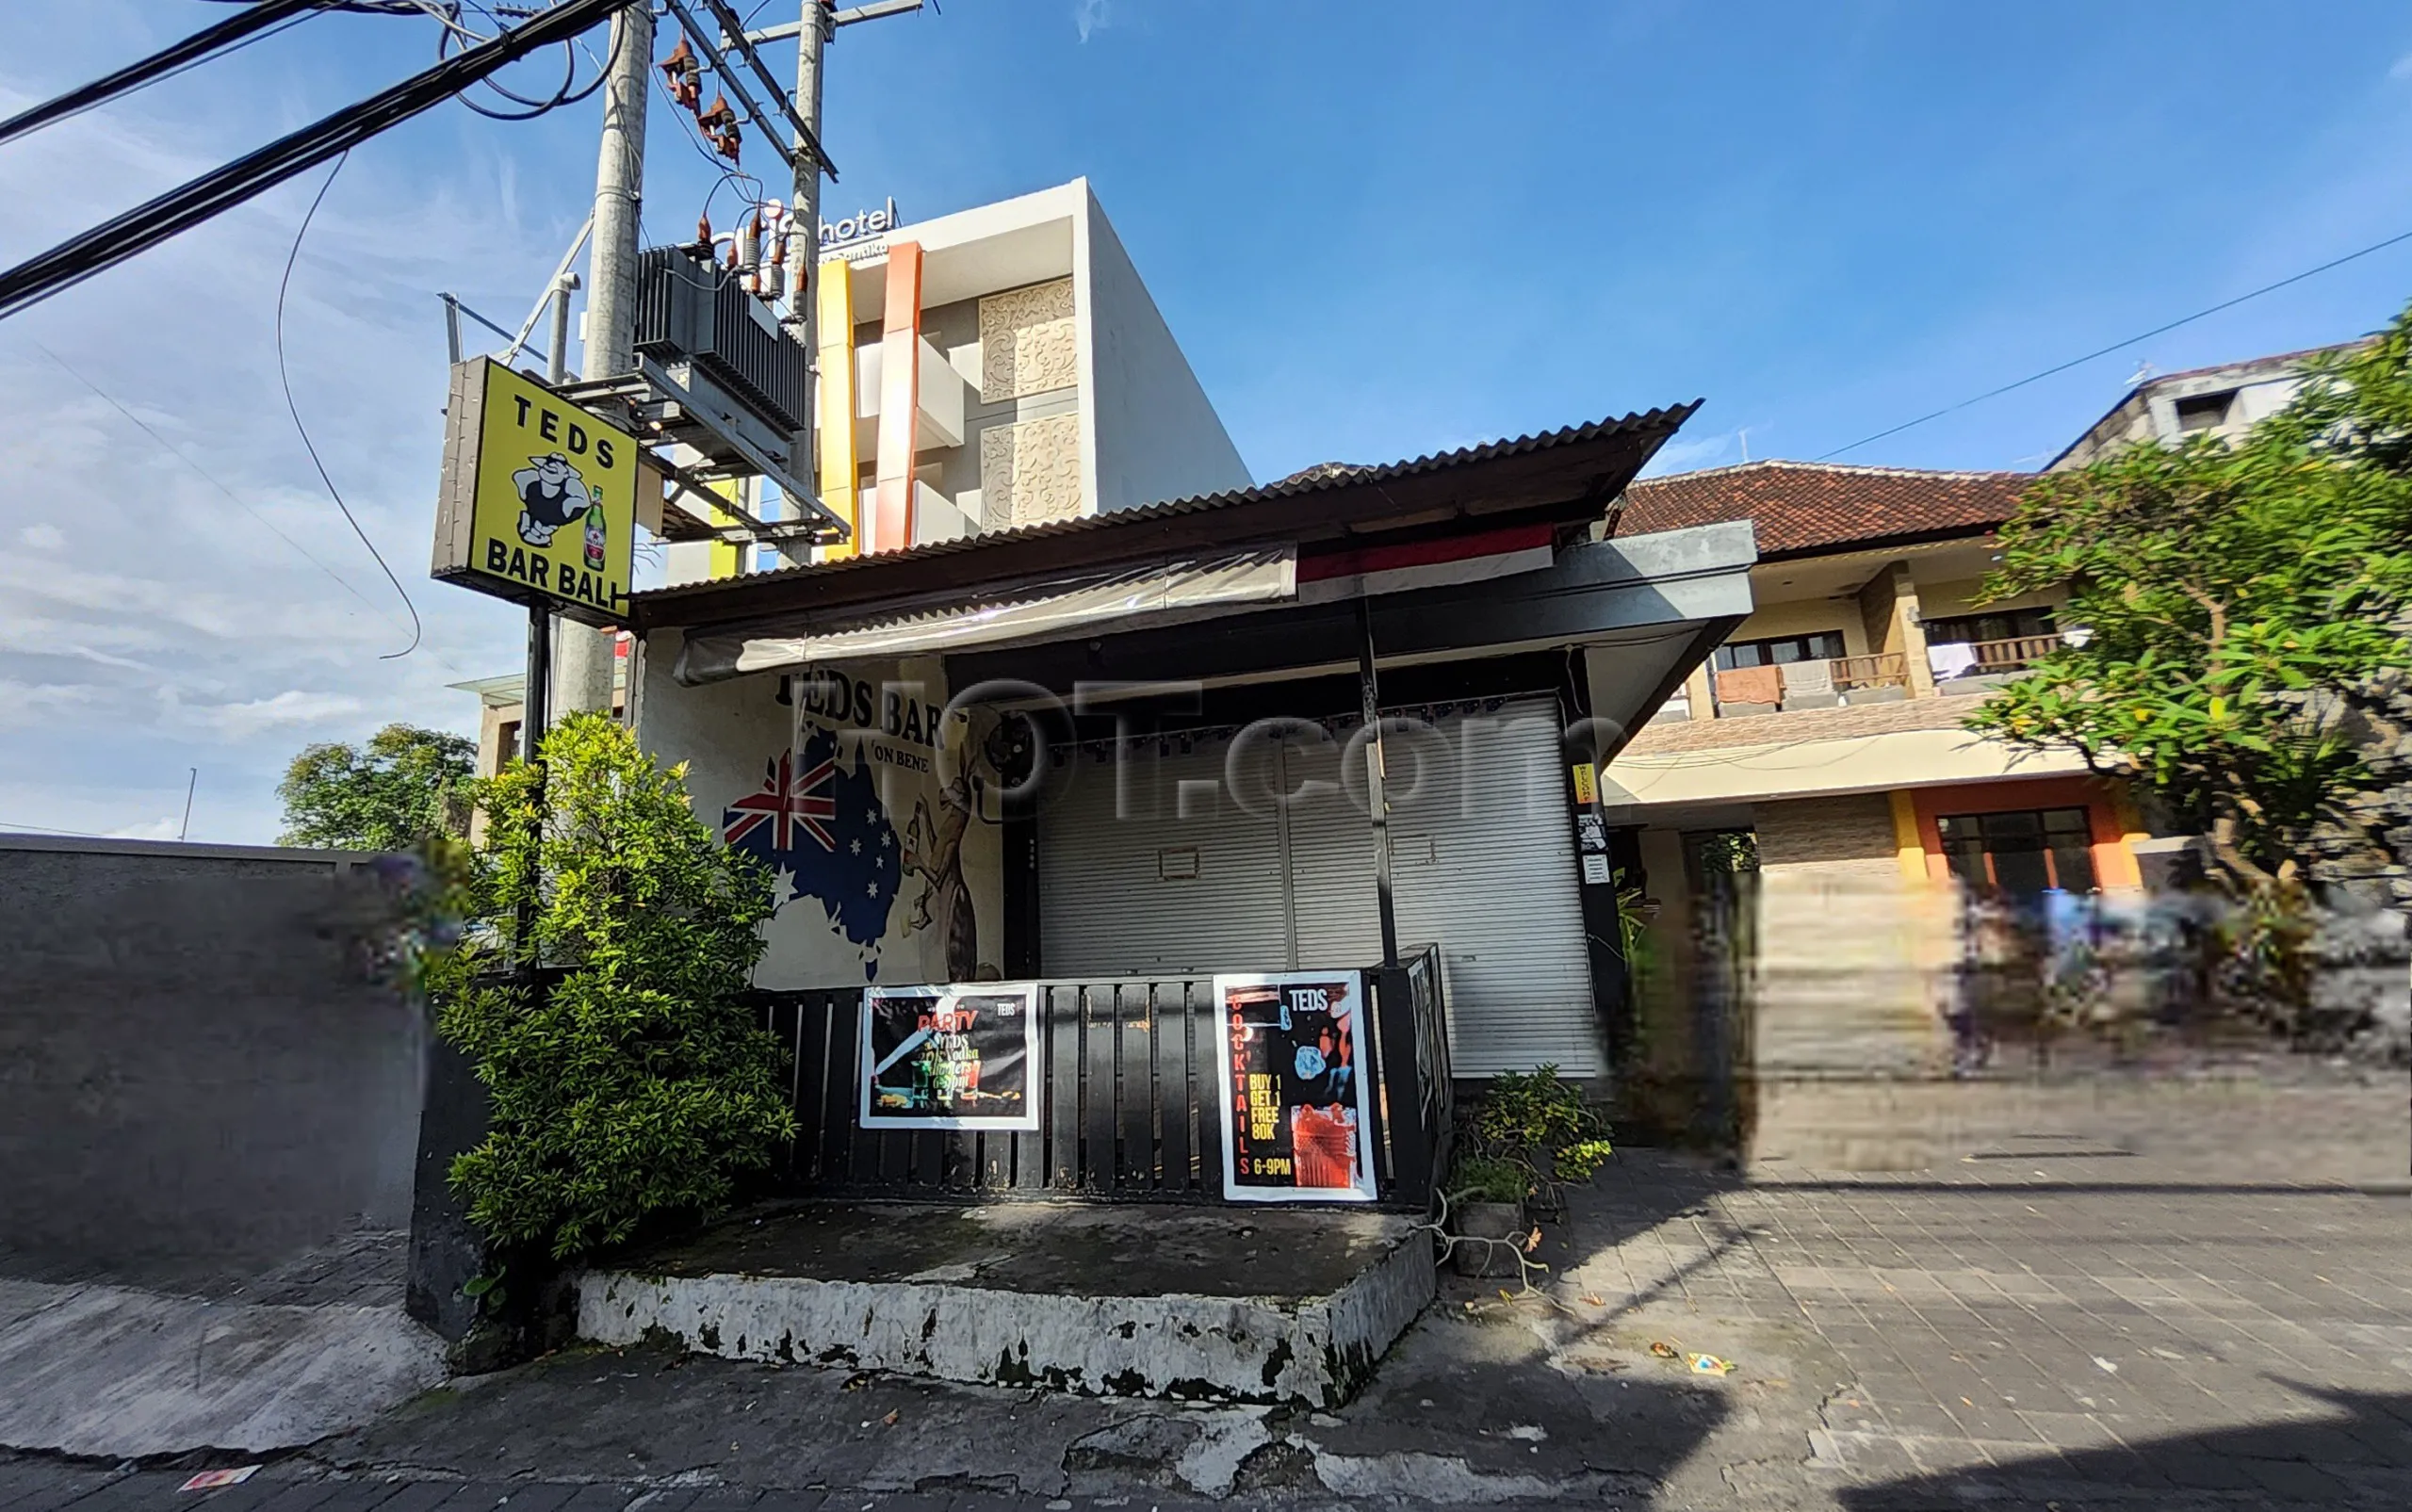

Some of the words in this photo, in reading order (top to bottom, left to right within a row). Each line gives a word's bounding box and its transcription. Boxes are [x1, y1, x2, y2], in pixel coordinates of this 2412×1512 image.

[818, 196, 893, 244] hotel
[514, 394, 613, 470] TEDS
[487, 537, 548, 588] BAR
[559, 562, 617, 611] BALI
[775, 668, 872, 727] TEDS
[882, 689, 945, 750] BAR
[896, 751, 929, 773] BENE
[997, 1003, 1016, 1016] TEDS
[1289, 989, 1328, 1012] TEDS
[918, 1010, 979, 1032] PARTY
[1231, 995, 1250, 1175] COCKTAILS
[1248, 1073, 1272, 1090] BUY
[1275, 1075, 1281, 1089] 1
[1249, 1090, 1273, 1107] GET
[1275, 1091, 1281, 1106] 1
[1251, 1107, 1279, 1123] FREE
[1251, 1123, 1276, 1140] 80K
[1254, 1158, 1291, 1176] 6-9PM
